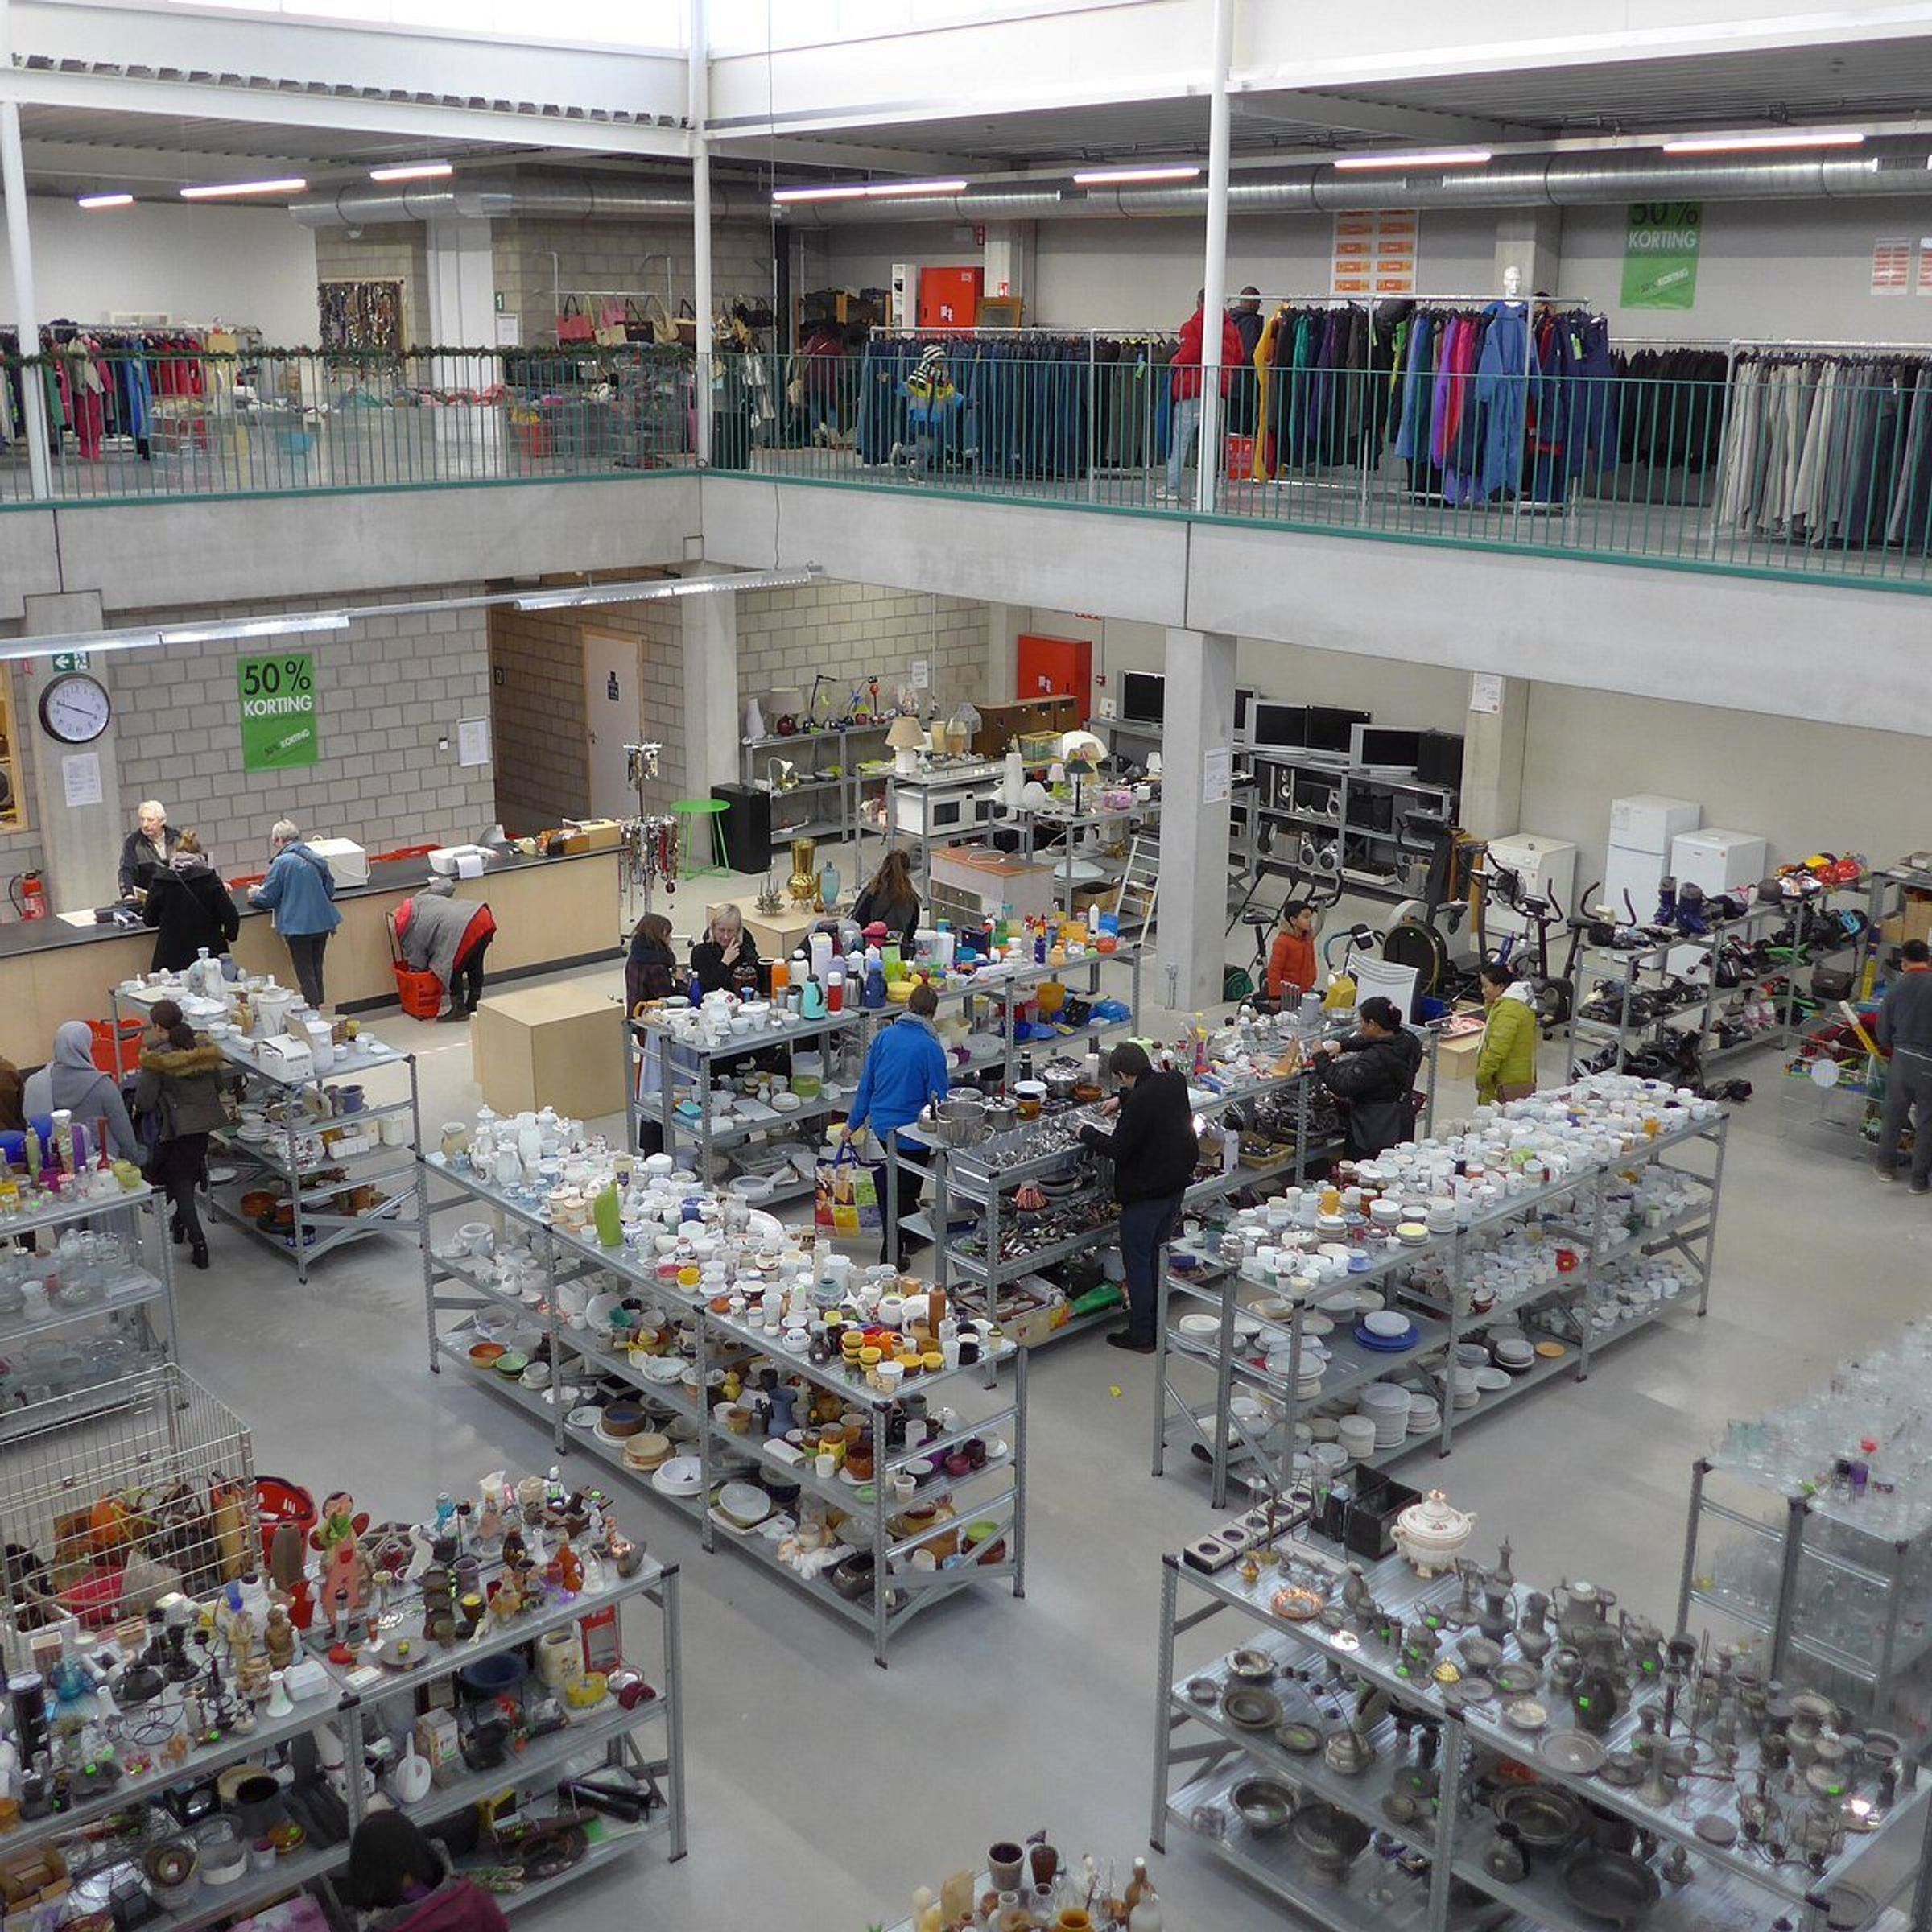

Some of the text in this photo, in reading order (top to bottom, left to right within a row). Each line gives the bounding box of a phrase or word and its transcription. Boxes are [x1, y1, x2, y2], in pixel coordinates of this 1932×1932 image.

[1628, 230, 1697, 248] KORTING
[497, 294, 502, 309] 1
[243, 694, 312, 717] KORTING
